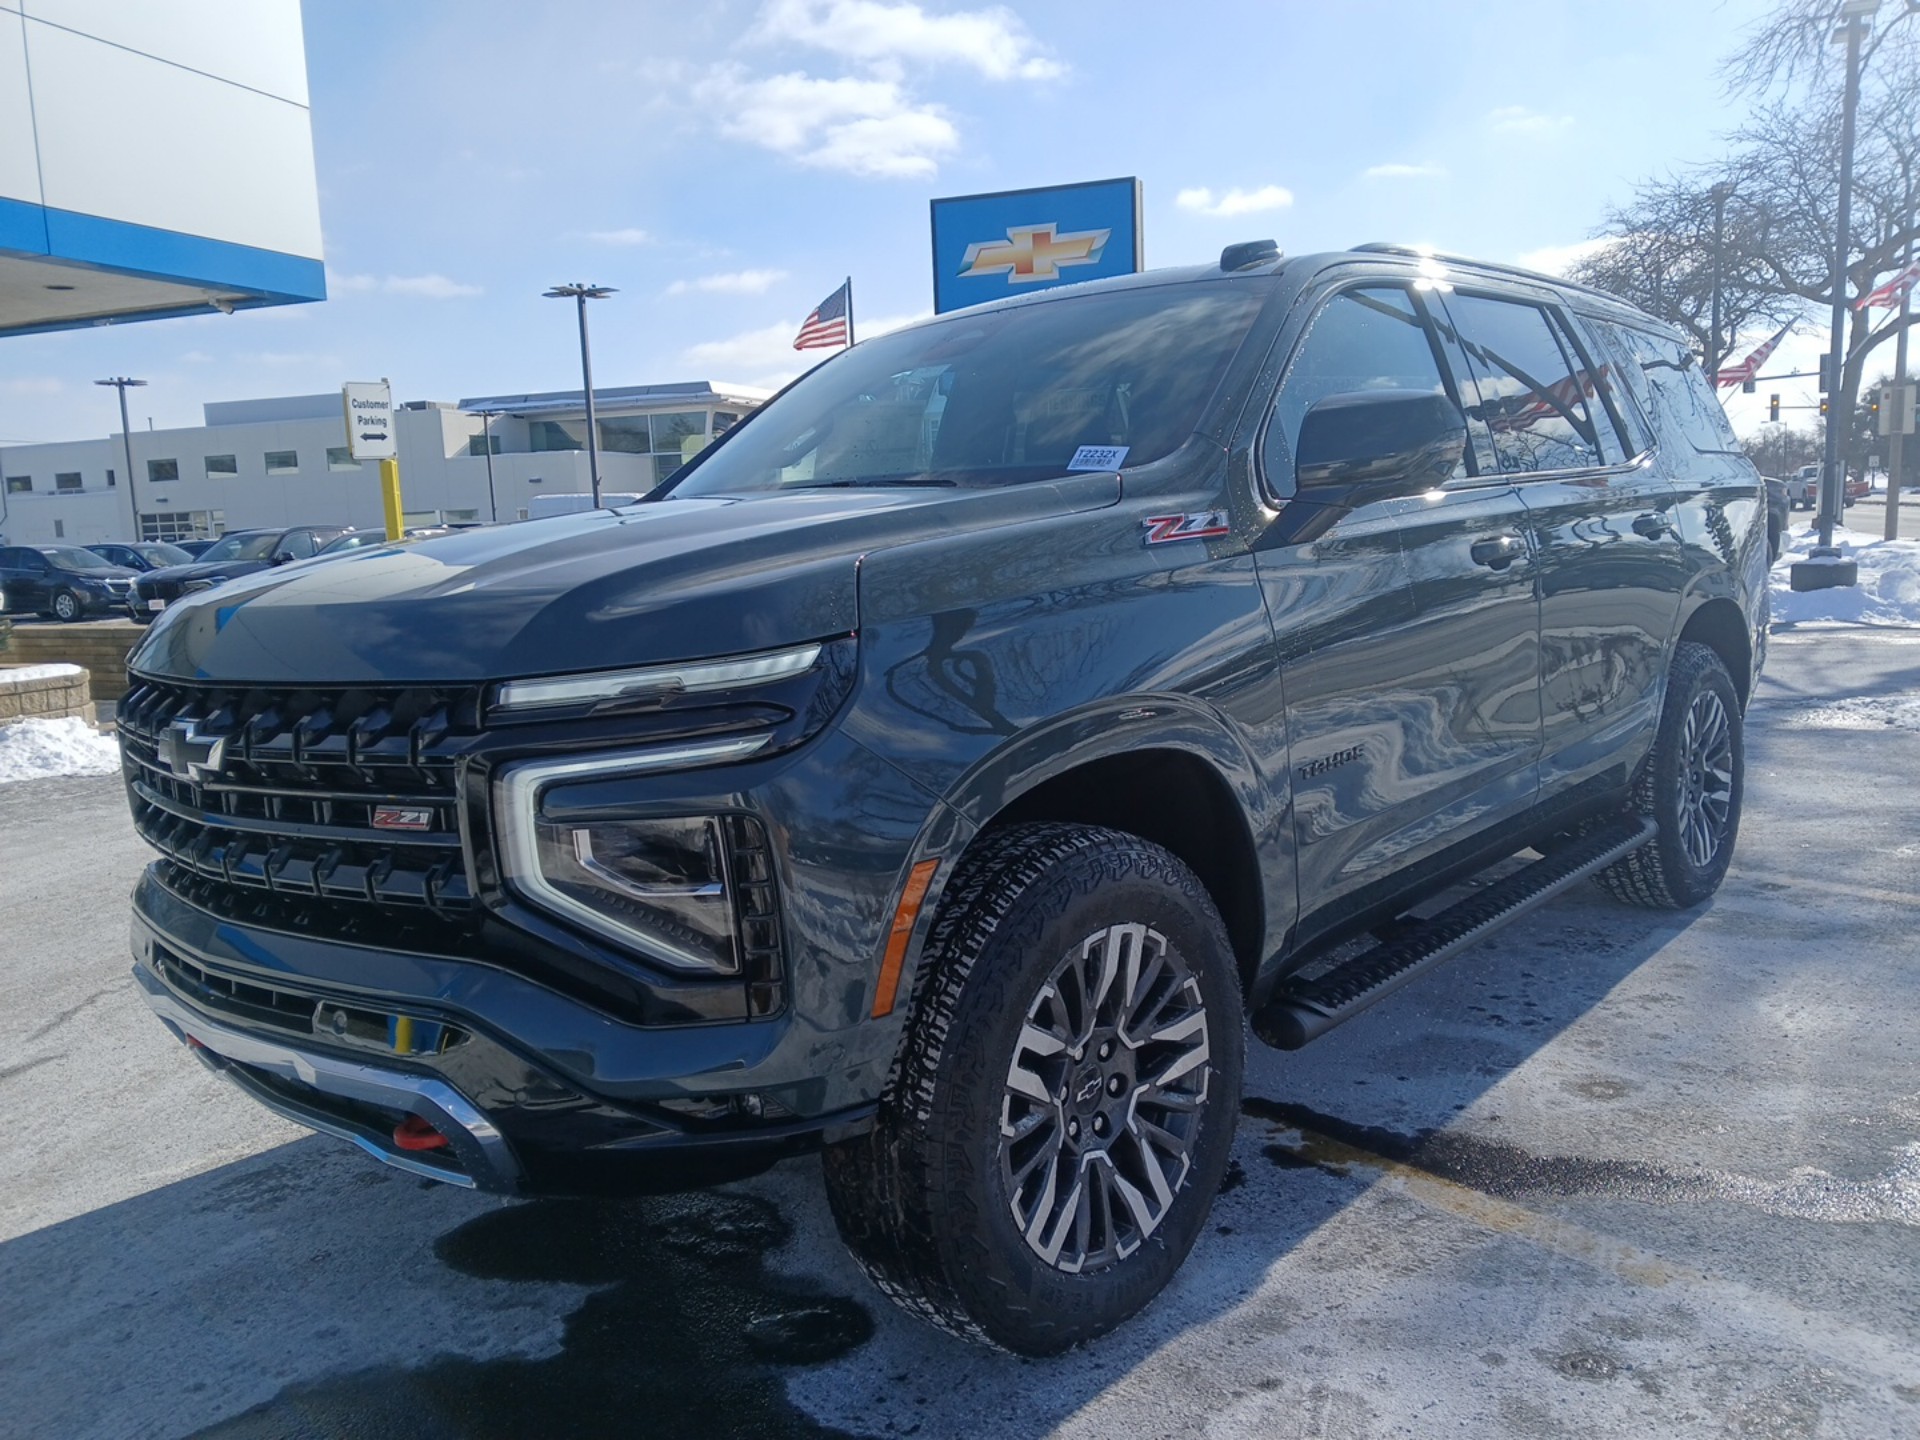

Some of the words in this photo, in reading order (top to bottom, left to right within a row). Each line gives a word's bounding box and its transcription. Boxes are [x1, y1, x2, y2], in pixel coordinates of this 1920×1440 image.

[352, 398, 389, 409] Customer
[357, 416, 387, 428] Parking
[1142, 509, 1230, 545] Z71
[1298, 743, 1365, 780] TAHOE
[373, 810, 430, 829] Z71
